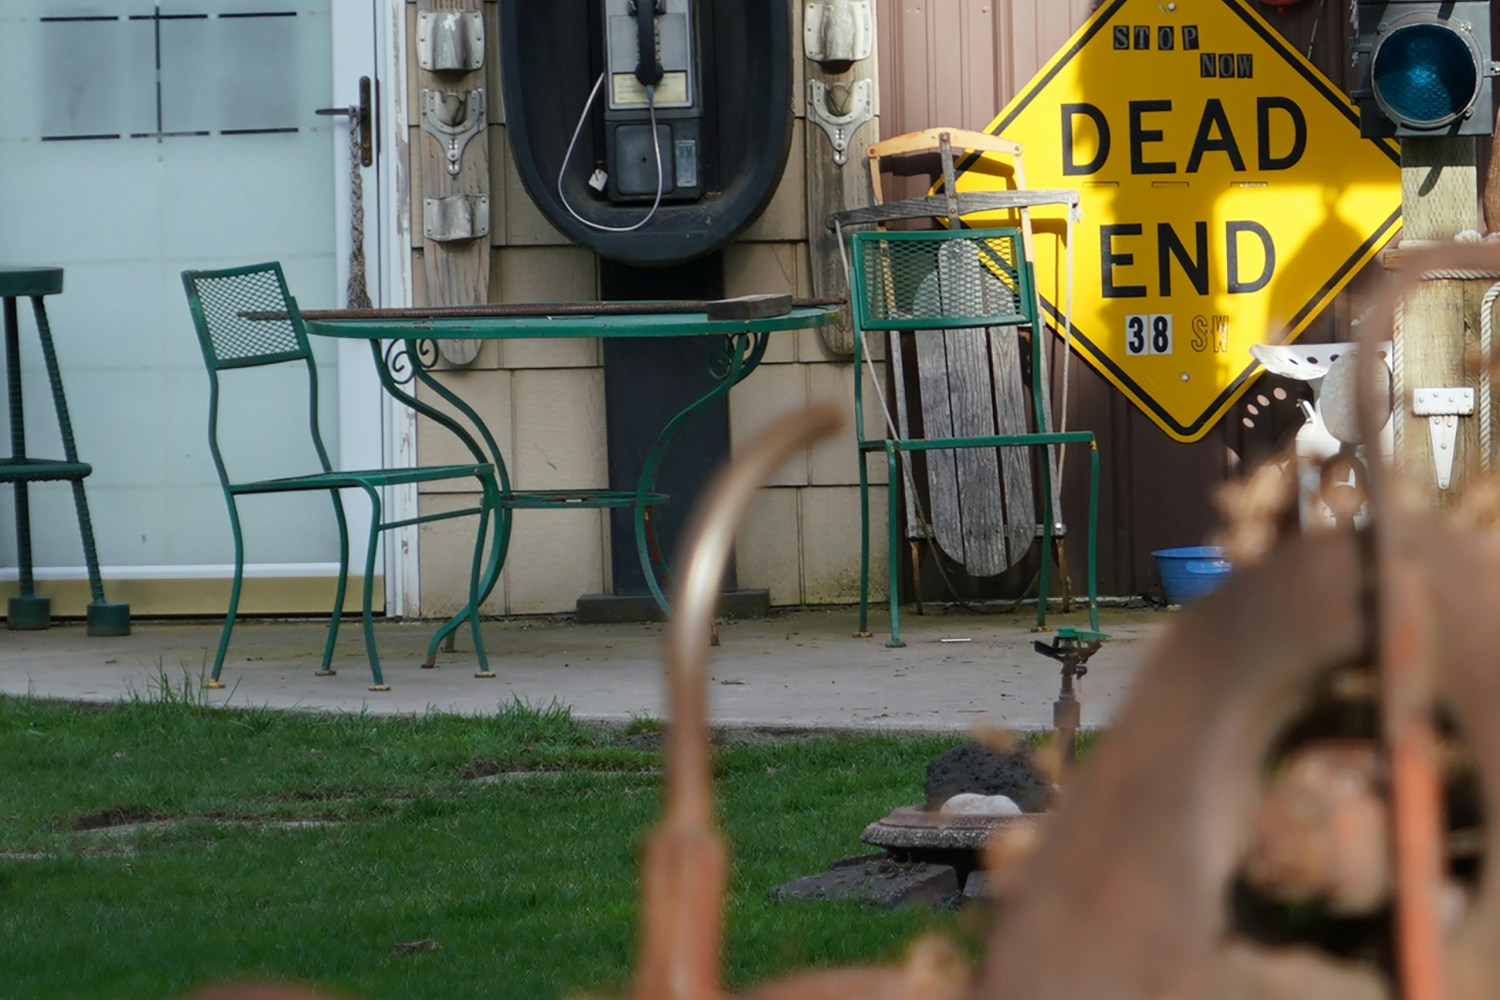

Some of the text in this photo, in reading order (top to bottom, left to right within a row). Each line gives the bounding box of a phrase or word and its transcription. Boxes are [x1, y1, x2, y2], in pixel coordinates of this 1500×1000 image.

[1115, 26, 1198, 49] STOP
[1202, 54, 1253, 77] NOW
[1061, 96, 1307, 176] DEAD
[1100, 221, 1276, 298] END
[1128, 314, 1229, 353] 38 SW
